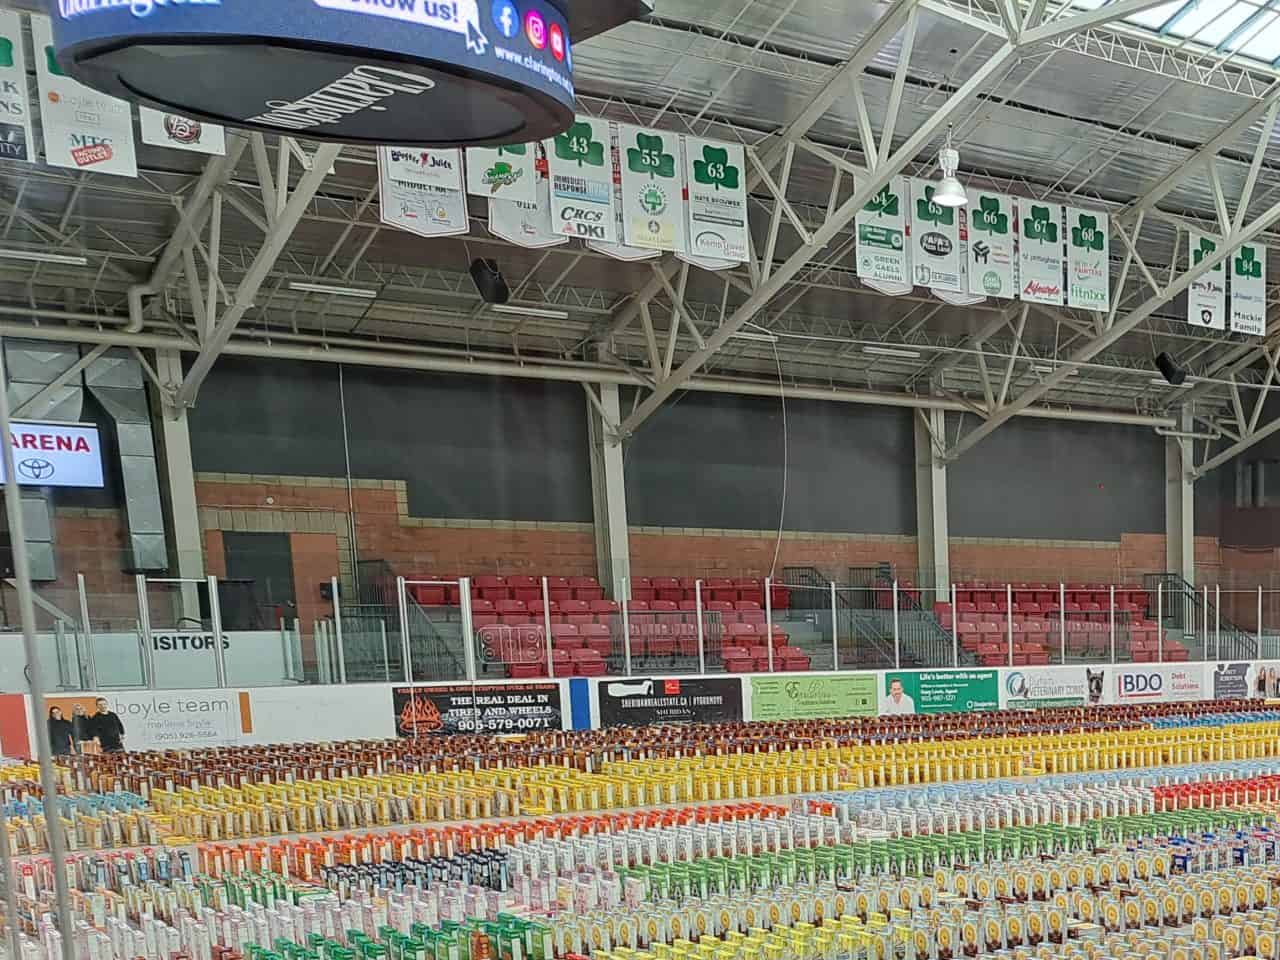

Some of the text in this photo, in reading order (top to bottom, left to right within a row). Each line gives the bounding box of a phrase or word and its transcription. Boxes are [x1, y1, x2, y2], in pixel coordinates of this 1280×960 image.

[423, 2, 458, 22] us!
[245, 65, 435, 129] Clarington
[569, 137, 588, 153] 43
[642, 150, 660, 166] 55
[707, 162, 725, 179] 63
[560, 206, 603, 222] CRCS
[984, 211, 997, 224] 66
[577, 225, 605, 239] DKI
[1034, 221, 1047, 233] 67
[1081, 228, 1094, 242] 68
[10, 433, 91, 453] ARENA
[1123, 674, 1162, 692] BDO
[115, 696, 229, 719] boyle team
[450, 694, 549, 705] THE REAL DEAL IN
[448, 705, 552, 718] TIRES AND WHEELS
[458, 717, 551, 731] 905-579-0071
